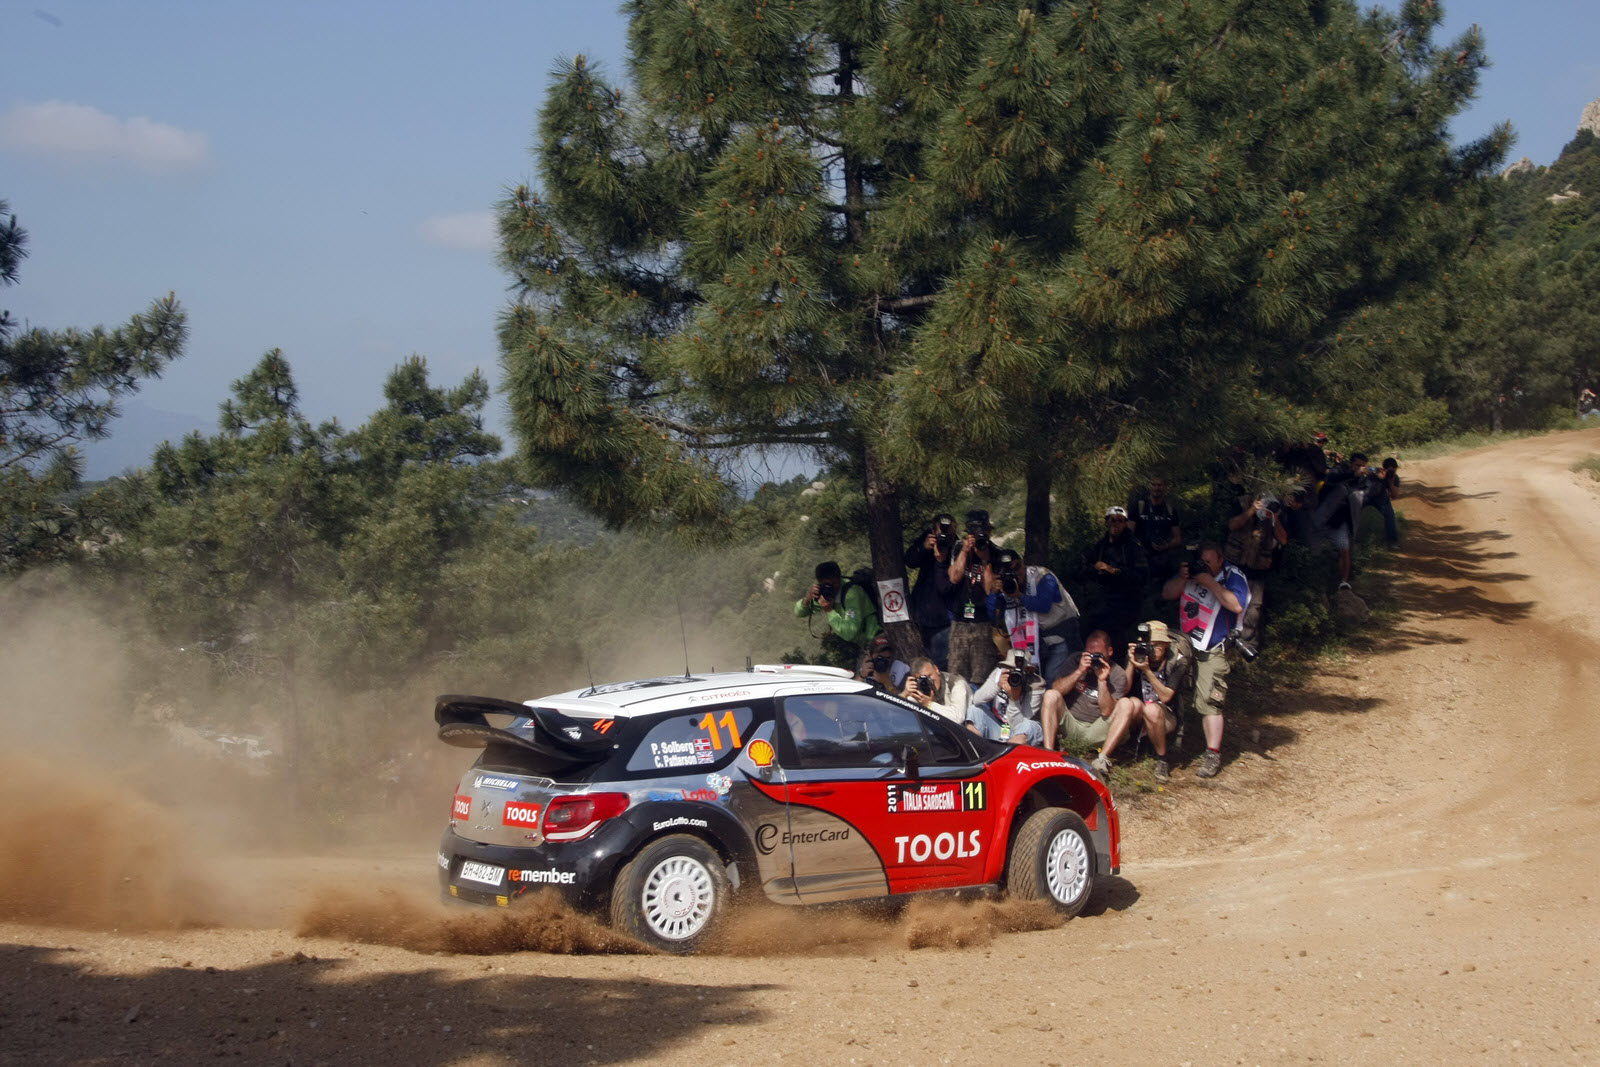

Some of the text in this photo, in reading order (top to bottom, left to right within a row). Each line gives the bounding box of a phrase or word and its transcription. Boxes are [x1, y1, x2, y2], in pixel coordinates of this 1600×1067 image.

[699, 710, 742, 750] 11
[651, 741, 695, 755] P. Solberg
[654, 753, 698, 768] C. Patterson
[483, 777, 518, 789] MICHELIN
[920, 785, 937, 793] RALLY
[887, 784, 897, 812] 2011
[902, 789, 955, 811] ITALIA SARDEGNA
[965, 782, 983, 810] 11
[455, 800, 469, 815] TOOLS
[507, 807, 537, 822] TOOLS
[653, 816, 708, 831] EuroLotto.com
[782, 827, 850, 844] EnterCard
[895, 829, 981, 864] TOOLS
[508, 867, 575, 883] re:member
